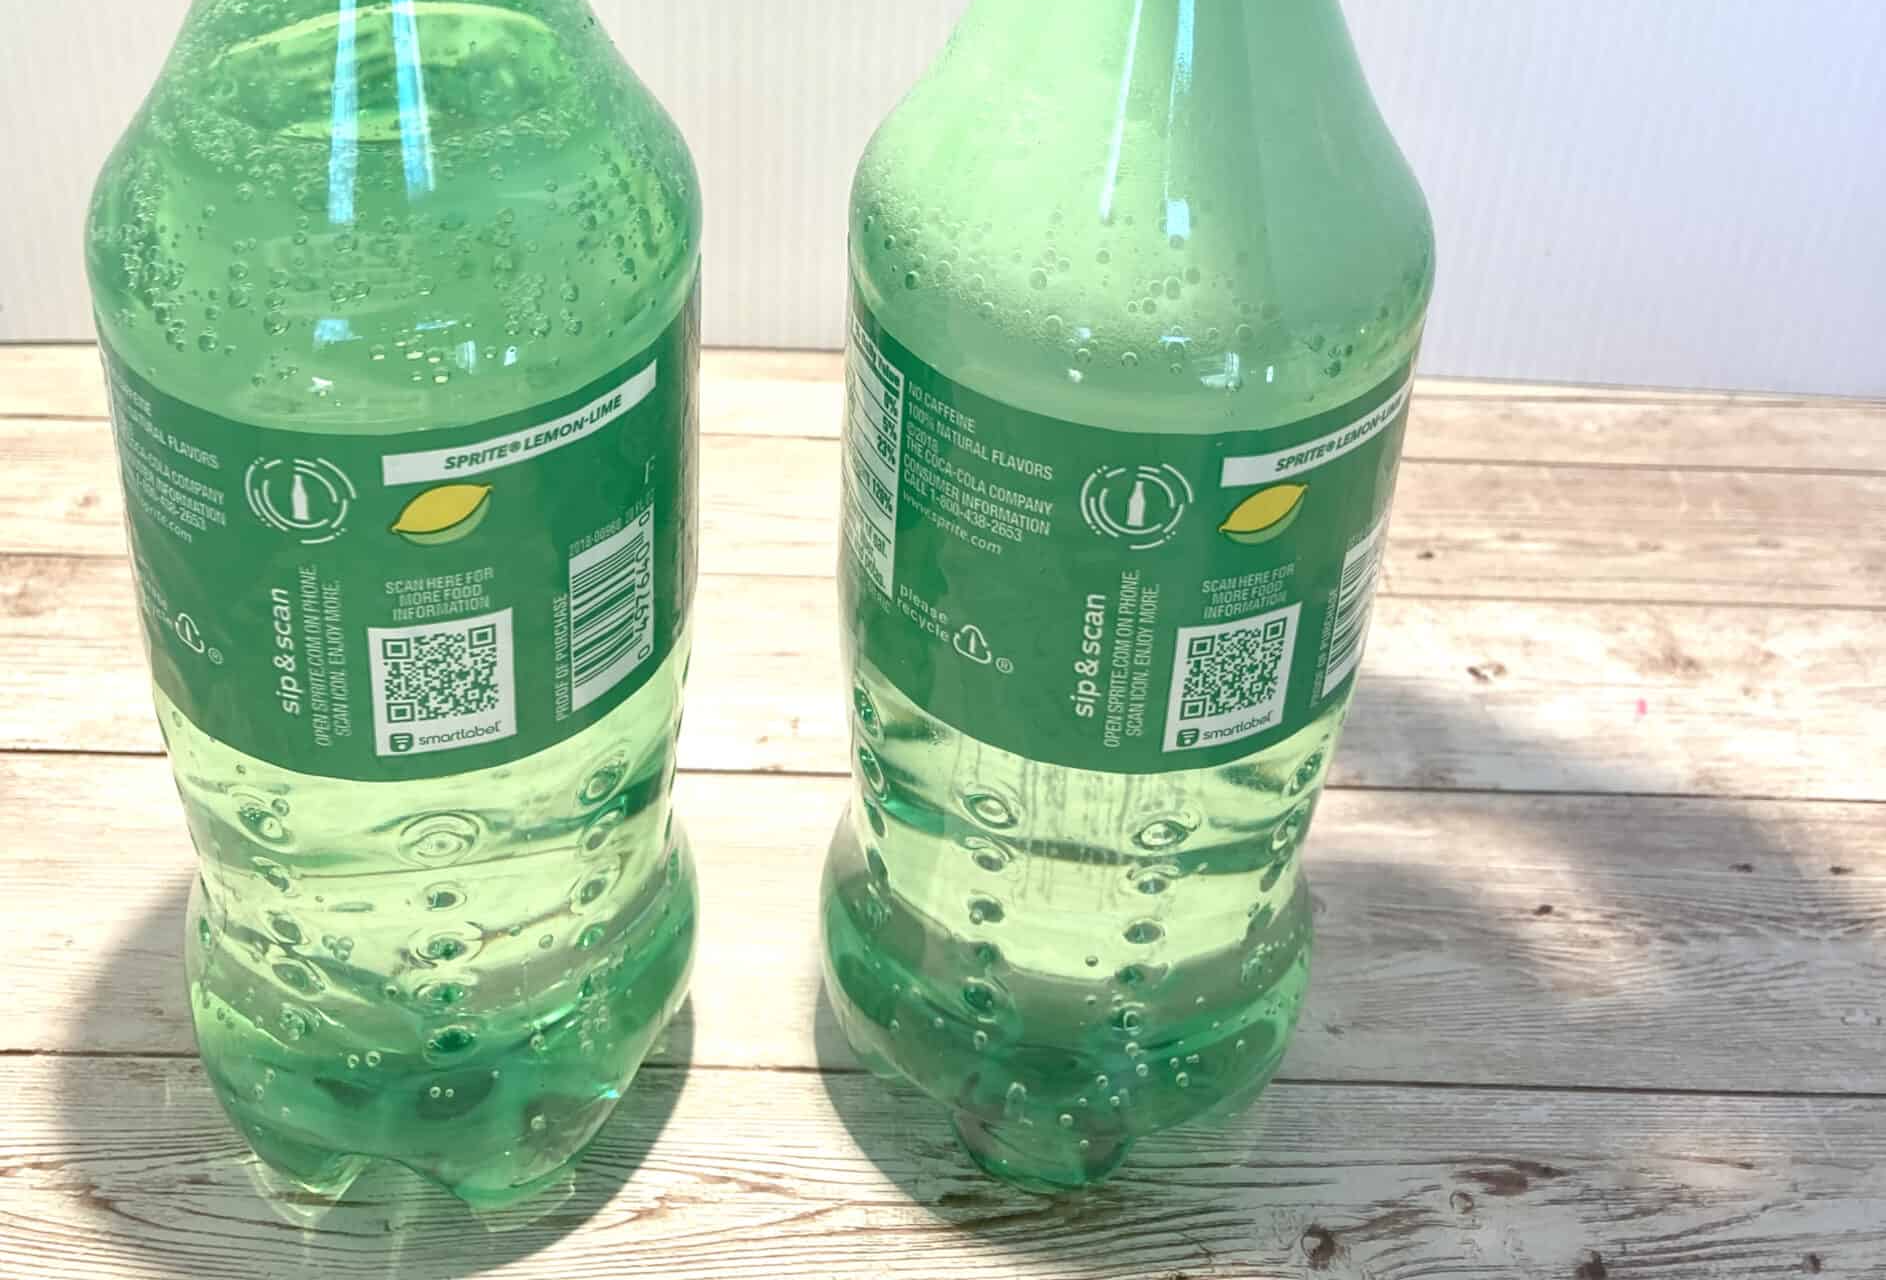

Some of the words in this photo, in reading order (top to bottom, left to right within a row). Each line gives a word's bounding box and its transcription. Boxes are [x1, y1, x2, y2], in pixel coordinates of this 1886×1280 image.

[523, 394, 623, 451] LEMON-LIME
[909, 381, 923, 400] NO
[924, 393, 976, 433] CAFFEINE
[936, 421, 989, 461] NATURAL
[991, 448, 1053, 481] FLAVORS
[903, 453, 960, 501] CONSUMER
[961, 492, 1050, 536] INFORMATION
[906, 437, 924, 459] THE
[924, 448, 986, 496] COCA-COLA
[988, 483, 1053, 516] COMPANY
[903, 469, 928, 496] CALL
[930, 489, 1023, 542] 1-800-438-2653
[385, 579, 424, 595] SCAN
[426, 574, 463, 591] HERE
[465, 567, 495, 585] FOR
[399, 589, 440, 607] MORE
[443, 584, 483, 602] FOOD
[1118, 570, 1141, 615] PHONE.
[1202, 578, 1237, 593] SCAN
[1238, 571, 1270, 588] HERE
[1271, 563, 1296, 580] FOR
[1211, 588, 1248, 605] MORE
[1250, 580, 1283, 598] FOOD
[271, 587, 295, 651] scan
[392, 595, 490, 621] INFORMATION
[897, 597, 950, 642] recycle
[900, 583, 948, 625] please
[1203, 590, 1288, 619] INFORMATION
[303, 615, 322, 635] ON
[553, 592, 569, 661] PURCHASE
[1082, 593, 1106, 656] scan
[1115, 618, 1134, 637] ON
[274, 654, 296, 672] &
[325, 624, 346, 665] ENJOY
[1133, 627, 1153, 666] ENJOY
[304, 637, 329, 712] SPRITE.COM
[556, 663, 569, 679] OF
[1074, 659, 1099, 677] &
[1107, 639, 1133, 714] SPRITE.COM
[1130, 669, 1149, 702] ICON.
[275, 675, 303, 716] sip
[555, 680, 570, 721] PROOF
[1070, 679, 1101, 718] sip
[311, 716, 332, 747] OPEN
[331, 704, 352, 737] SCAN
[1103, 716, 1122, 748] OPEN
[1125, 703, 1145, 737] SCAN
